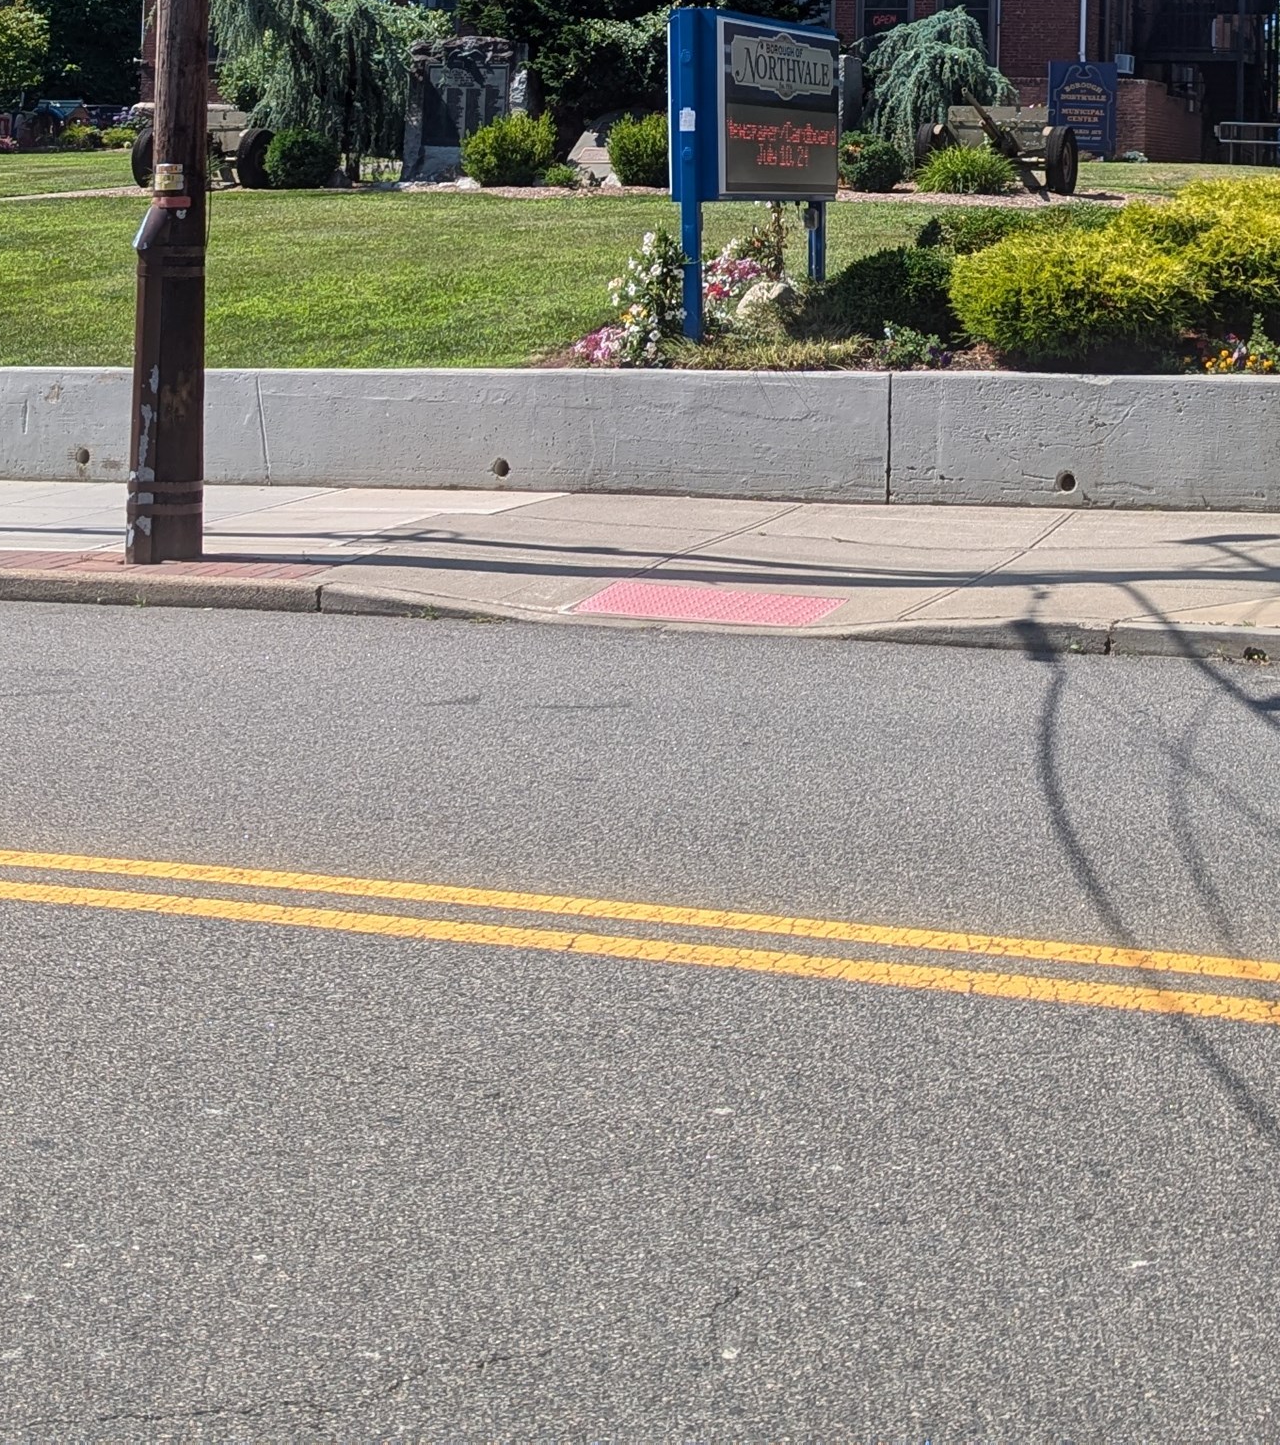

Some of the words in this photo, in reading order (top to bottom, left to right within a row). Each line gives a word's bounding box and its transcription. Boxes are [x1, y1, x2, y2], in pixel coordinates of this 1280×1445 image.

[766, 43, 795, 57] BOROUGH
[795, 48, 804, 59] OF
[735, 41, 829, 86] NORTHVALE
[1064, 82, 1103, 93] BOROUGH
[1061, 108, 1105, 116] MUNICIPAL
